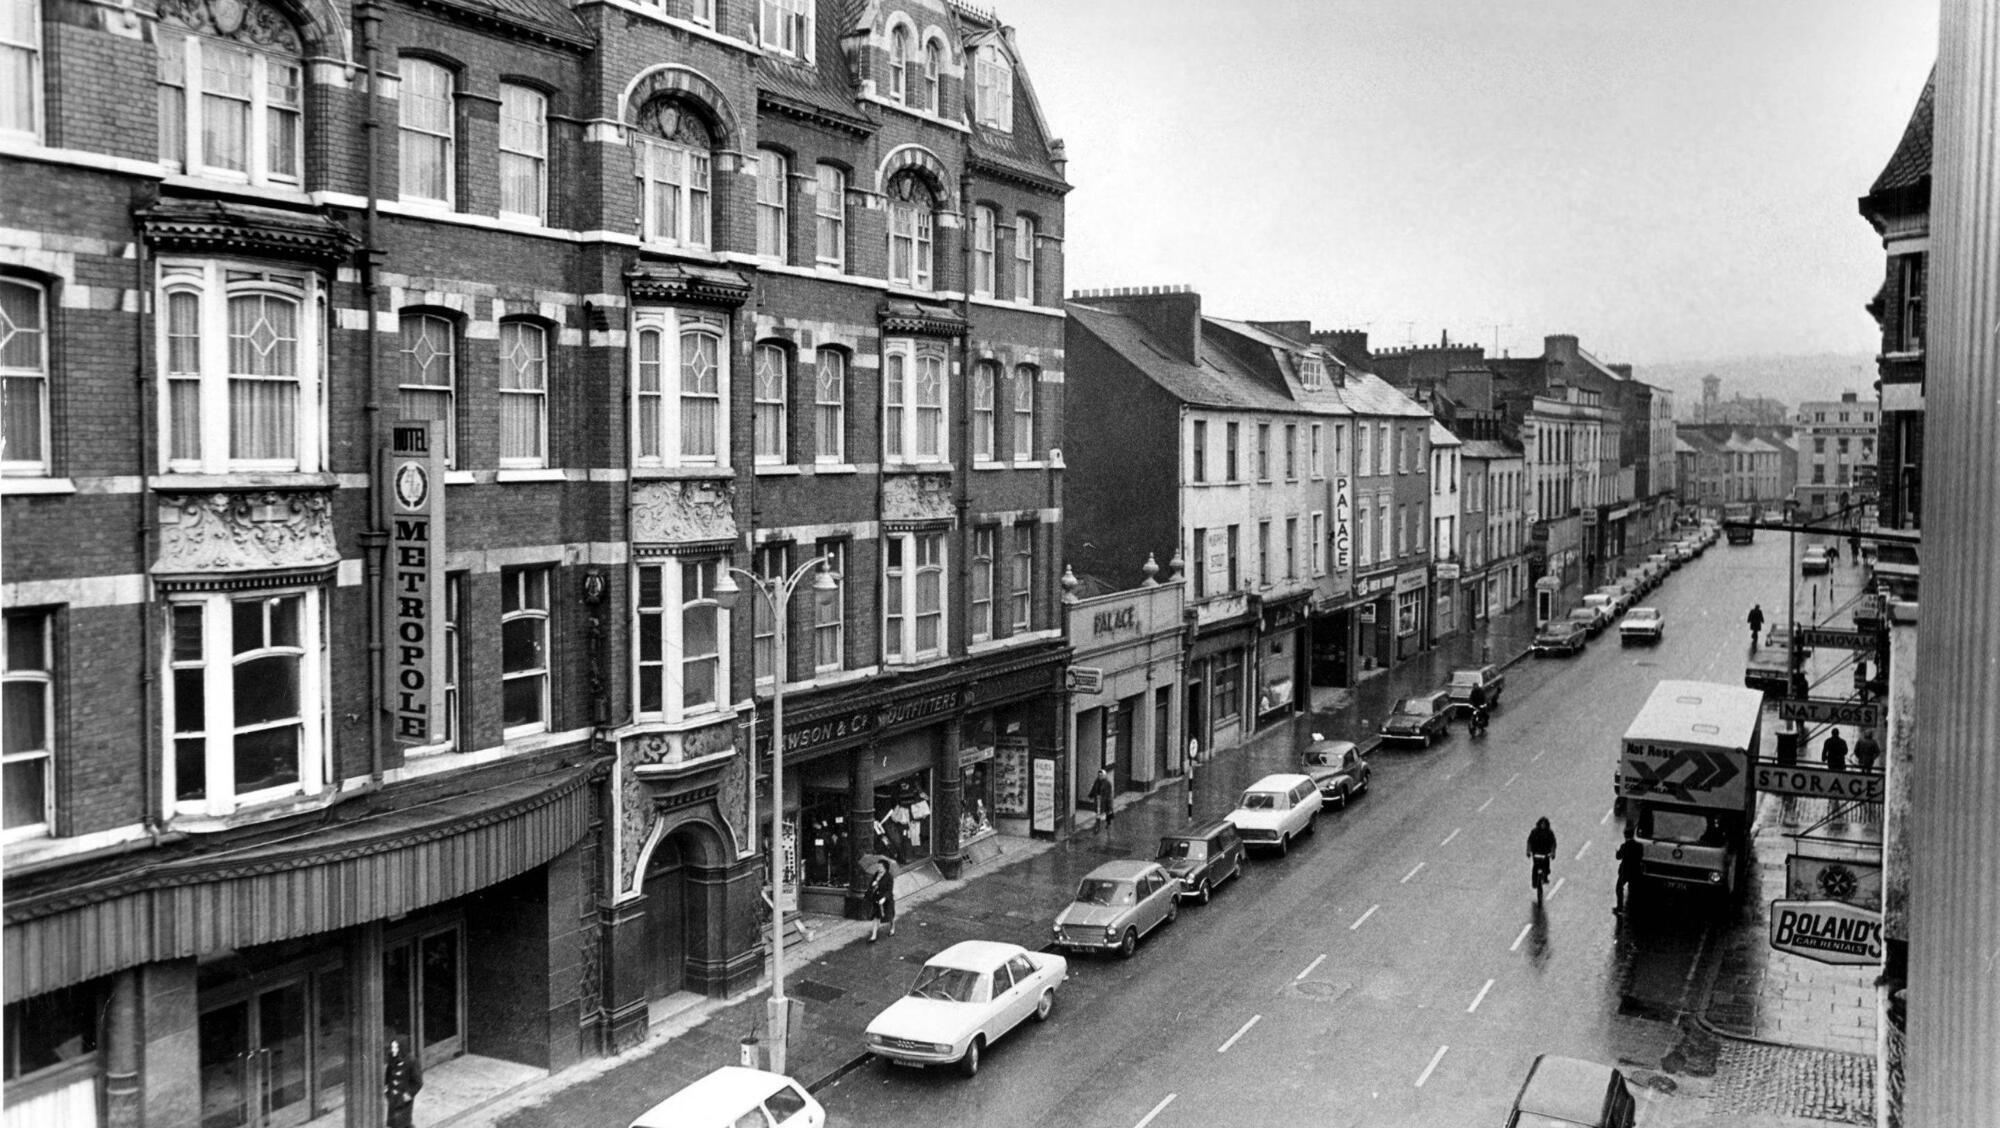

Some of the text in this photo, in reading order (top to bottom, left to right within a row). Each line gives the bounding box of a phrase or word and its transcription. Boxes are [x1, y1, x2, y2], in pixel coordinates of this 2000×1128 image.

[394, 427, 427, 451] HOTEL
[1337, 478, 1348, 566] PALACE
[394, 520, 428, 738] METROPOLE
[887, 692, 957, 724] OUTFITTERS
[1784, 703, 1873, 721] NAT ROSS
[1626, 742, 1644, 755] Nat
[1759, 770, 1878, 797] STORAGE
[1776, 910, 1882, 958] BOLAND'S
